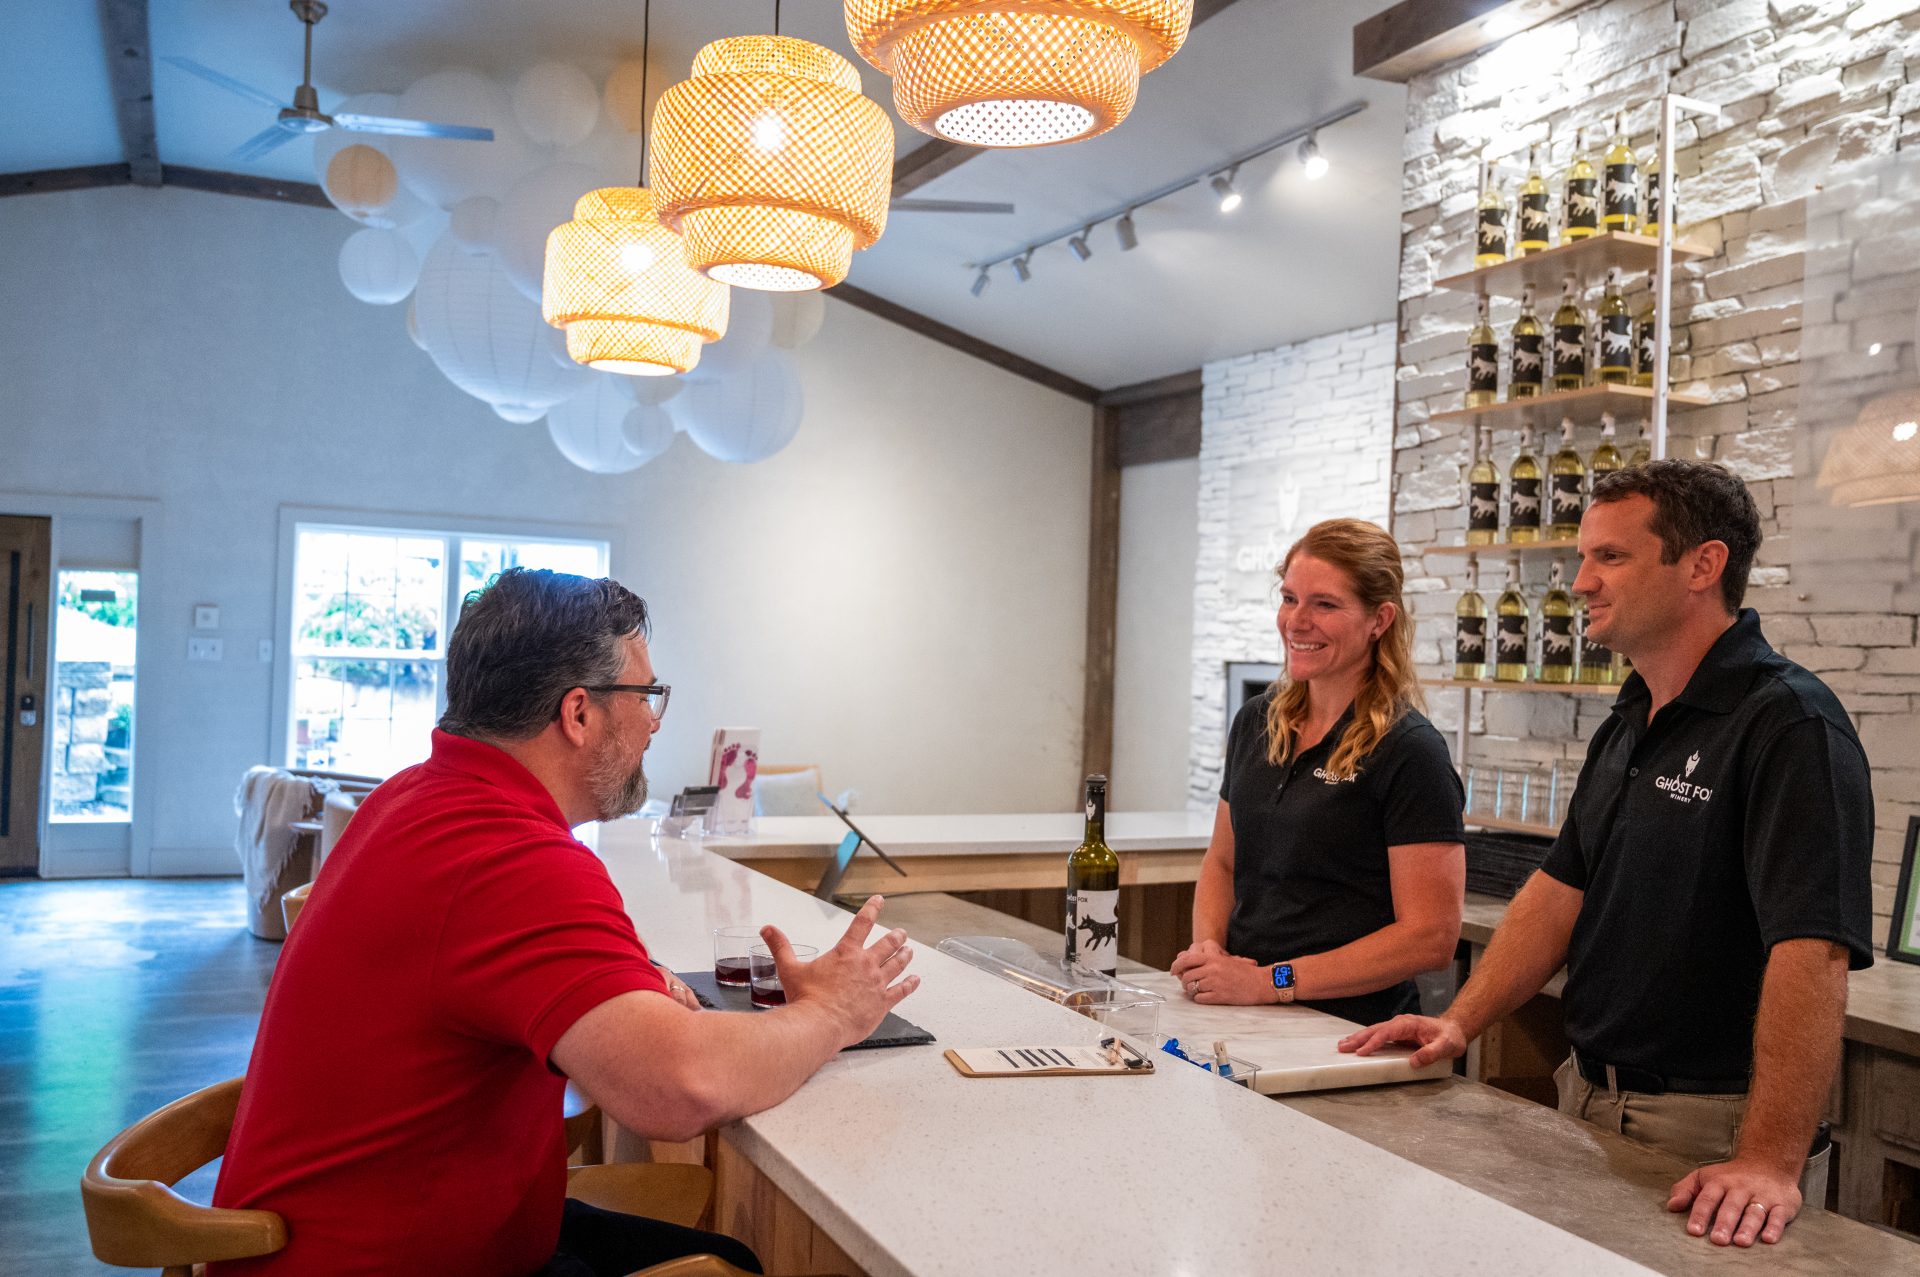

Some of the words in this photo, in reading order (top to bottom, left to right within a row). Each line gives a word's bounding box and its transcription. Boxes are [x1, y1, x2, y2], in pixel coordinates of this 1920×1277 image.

[1236, 533, 1279, 572] GHO
[1655, 774, 1693, 796] GHOST
[1670, 793, 1691, 804] WINERY
